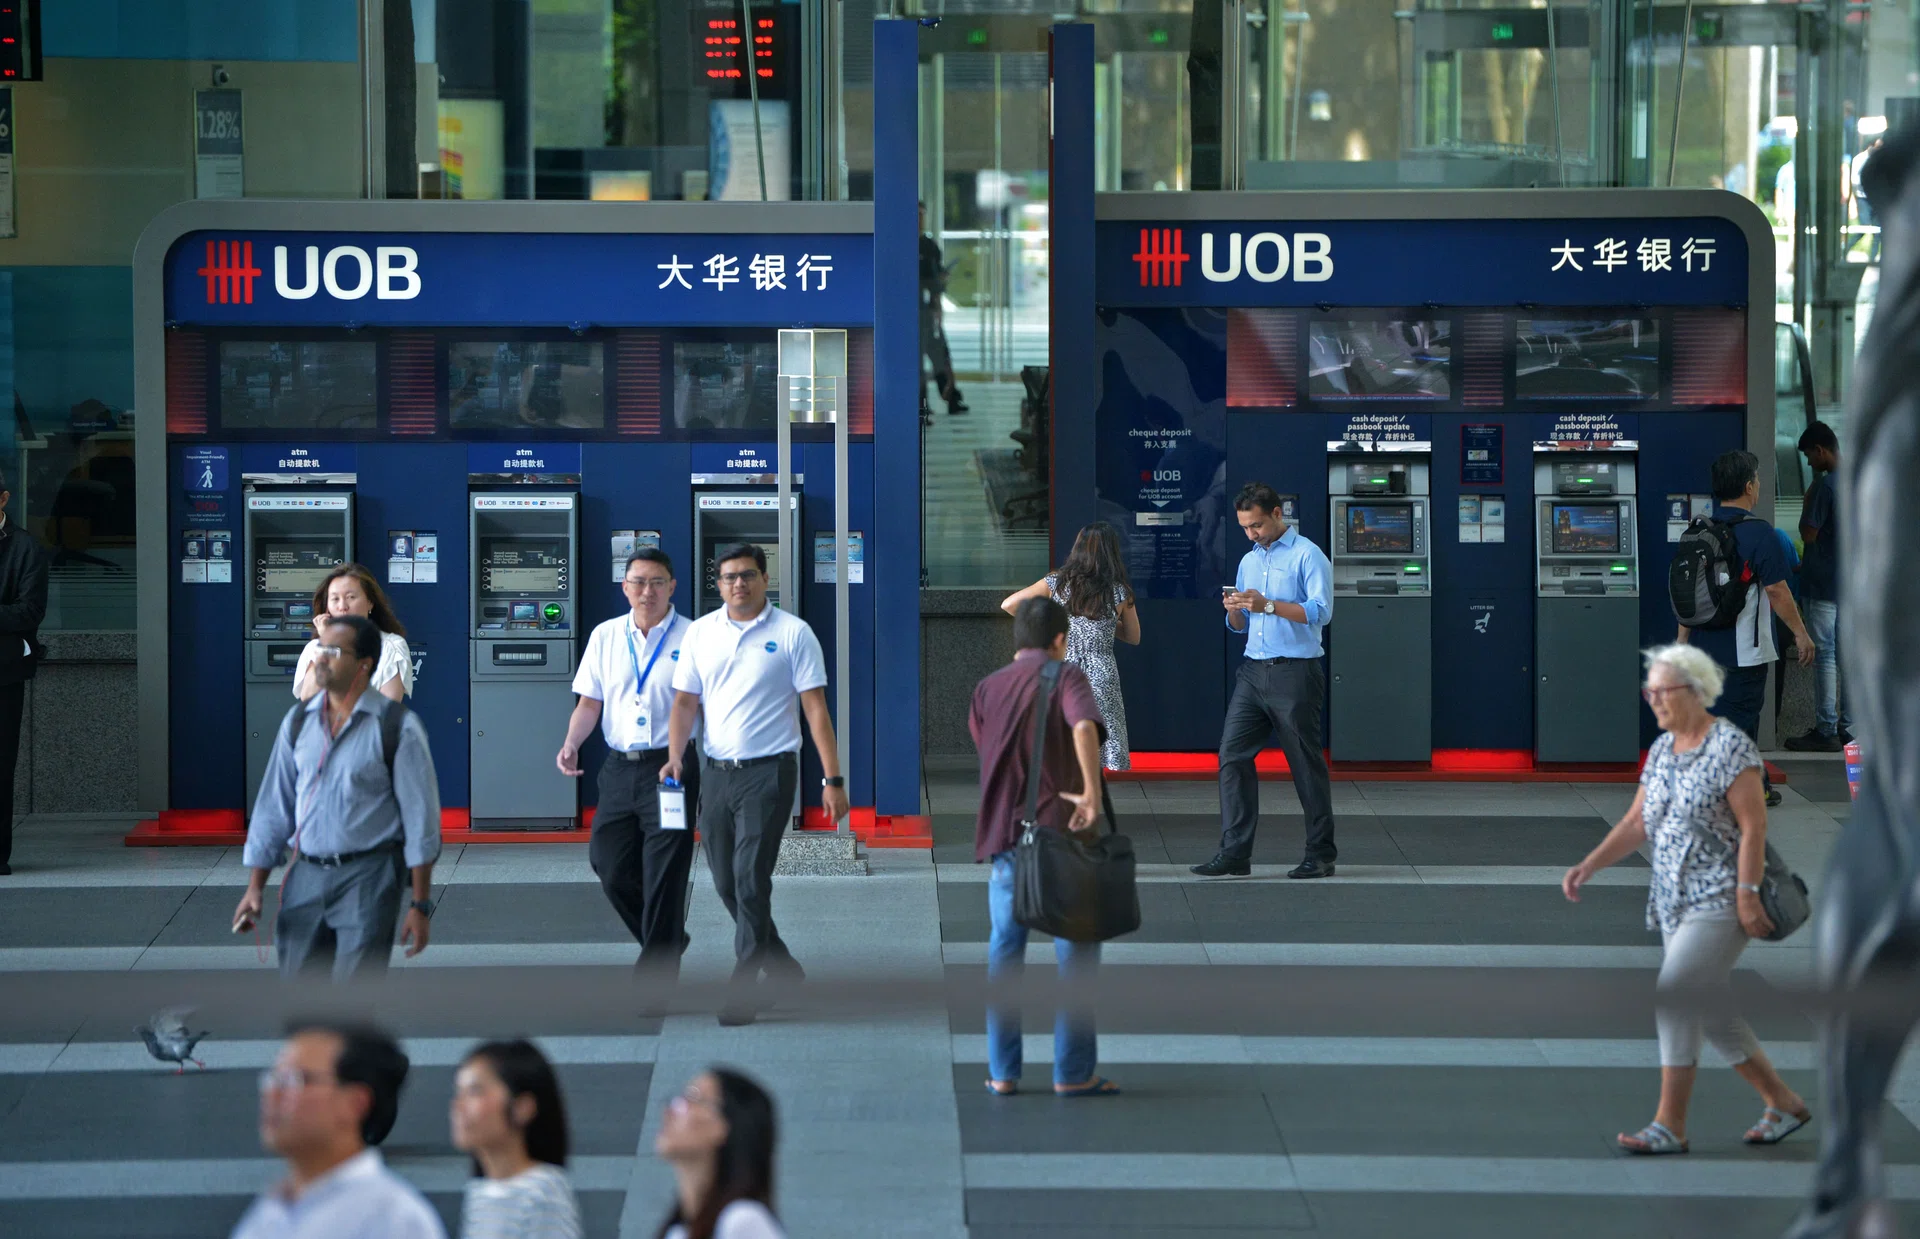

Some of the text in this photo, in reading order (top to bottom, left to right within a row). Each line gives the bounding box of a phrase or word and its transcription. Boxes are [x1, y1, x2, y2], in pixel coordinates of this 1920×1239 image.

[1202, 232, 1333, 282] UOB
[1551, 237, 1717, 273] 大华银行
[274, 245, 422, 300] UOB
[657, 253, 834, 291] 大华银行
[1352, 414, 1368, 422] cash
[1370, 414, 1398, 424] deposit
[1559, 413, 1576, 421] cash
[1578, 413, 1606, 423] deposit
[1347, 422, 1410, 432] passbook update
[1555, 421, 1618, 431] passbook update
[1128, 428, 1192, 439] cheque deposit
[291, 448, 308, 456] atm
[516, 448, 533, 456] atm
[739, 448, 756, 456] atm
[278, 459, 320, 468] 自动提款机
[503, 459, 545, 468] 自动提款机
[726, 459, 768, 468] 自动提款机
[1153, 470, 1182, 481] UOB
